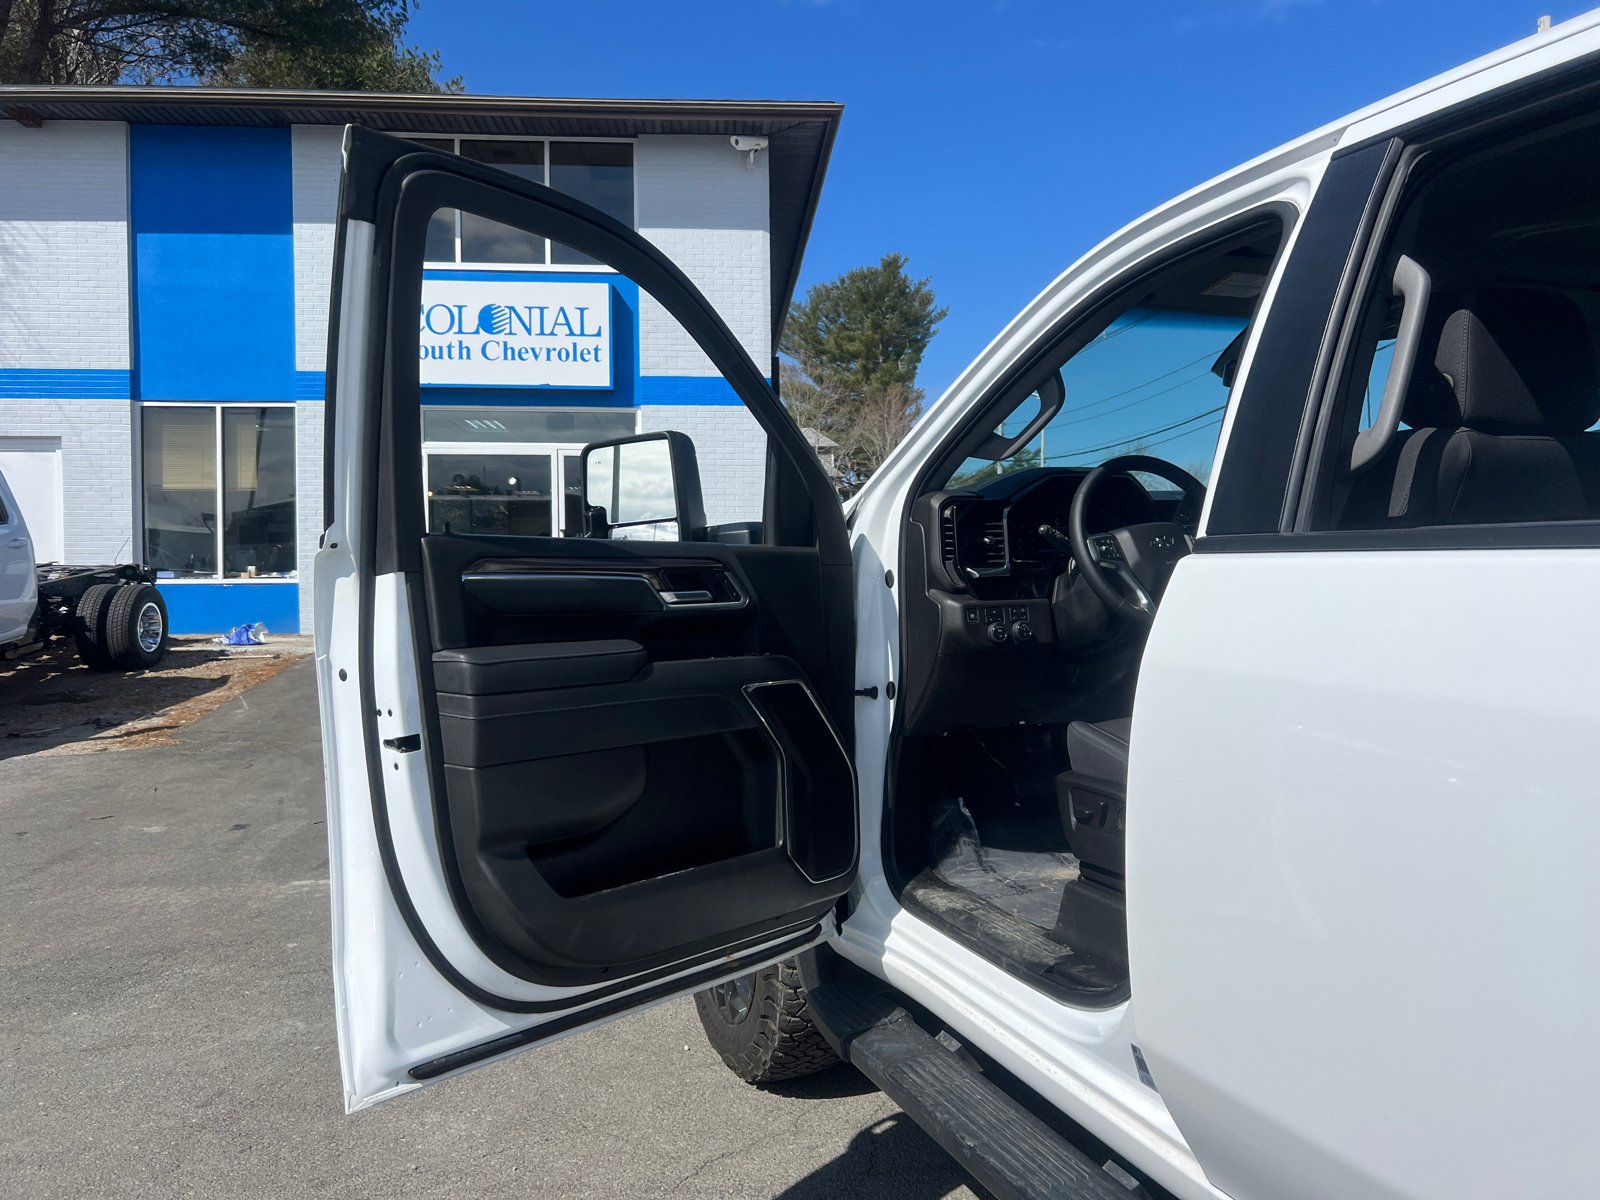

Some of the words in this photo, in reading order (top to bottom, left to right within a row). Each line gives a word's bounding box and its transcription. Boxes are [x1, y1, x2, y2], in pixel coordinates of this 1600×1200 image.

[420, 304, 602, 337] OLONIAL
[420, 340, 472, 360] outh
[481, 340, 602, 363] Chevrolet
